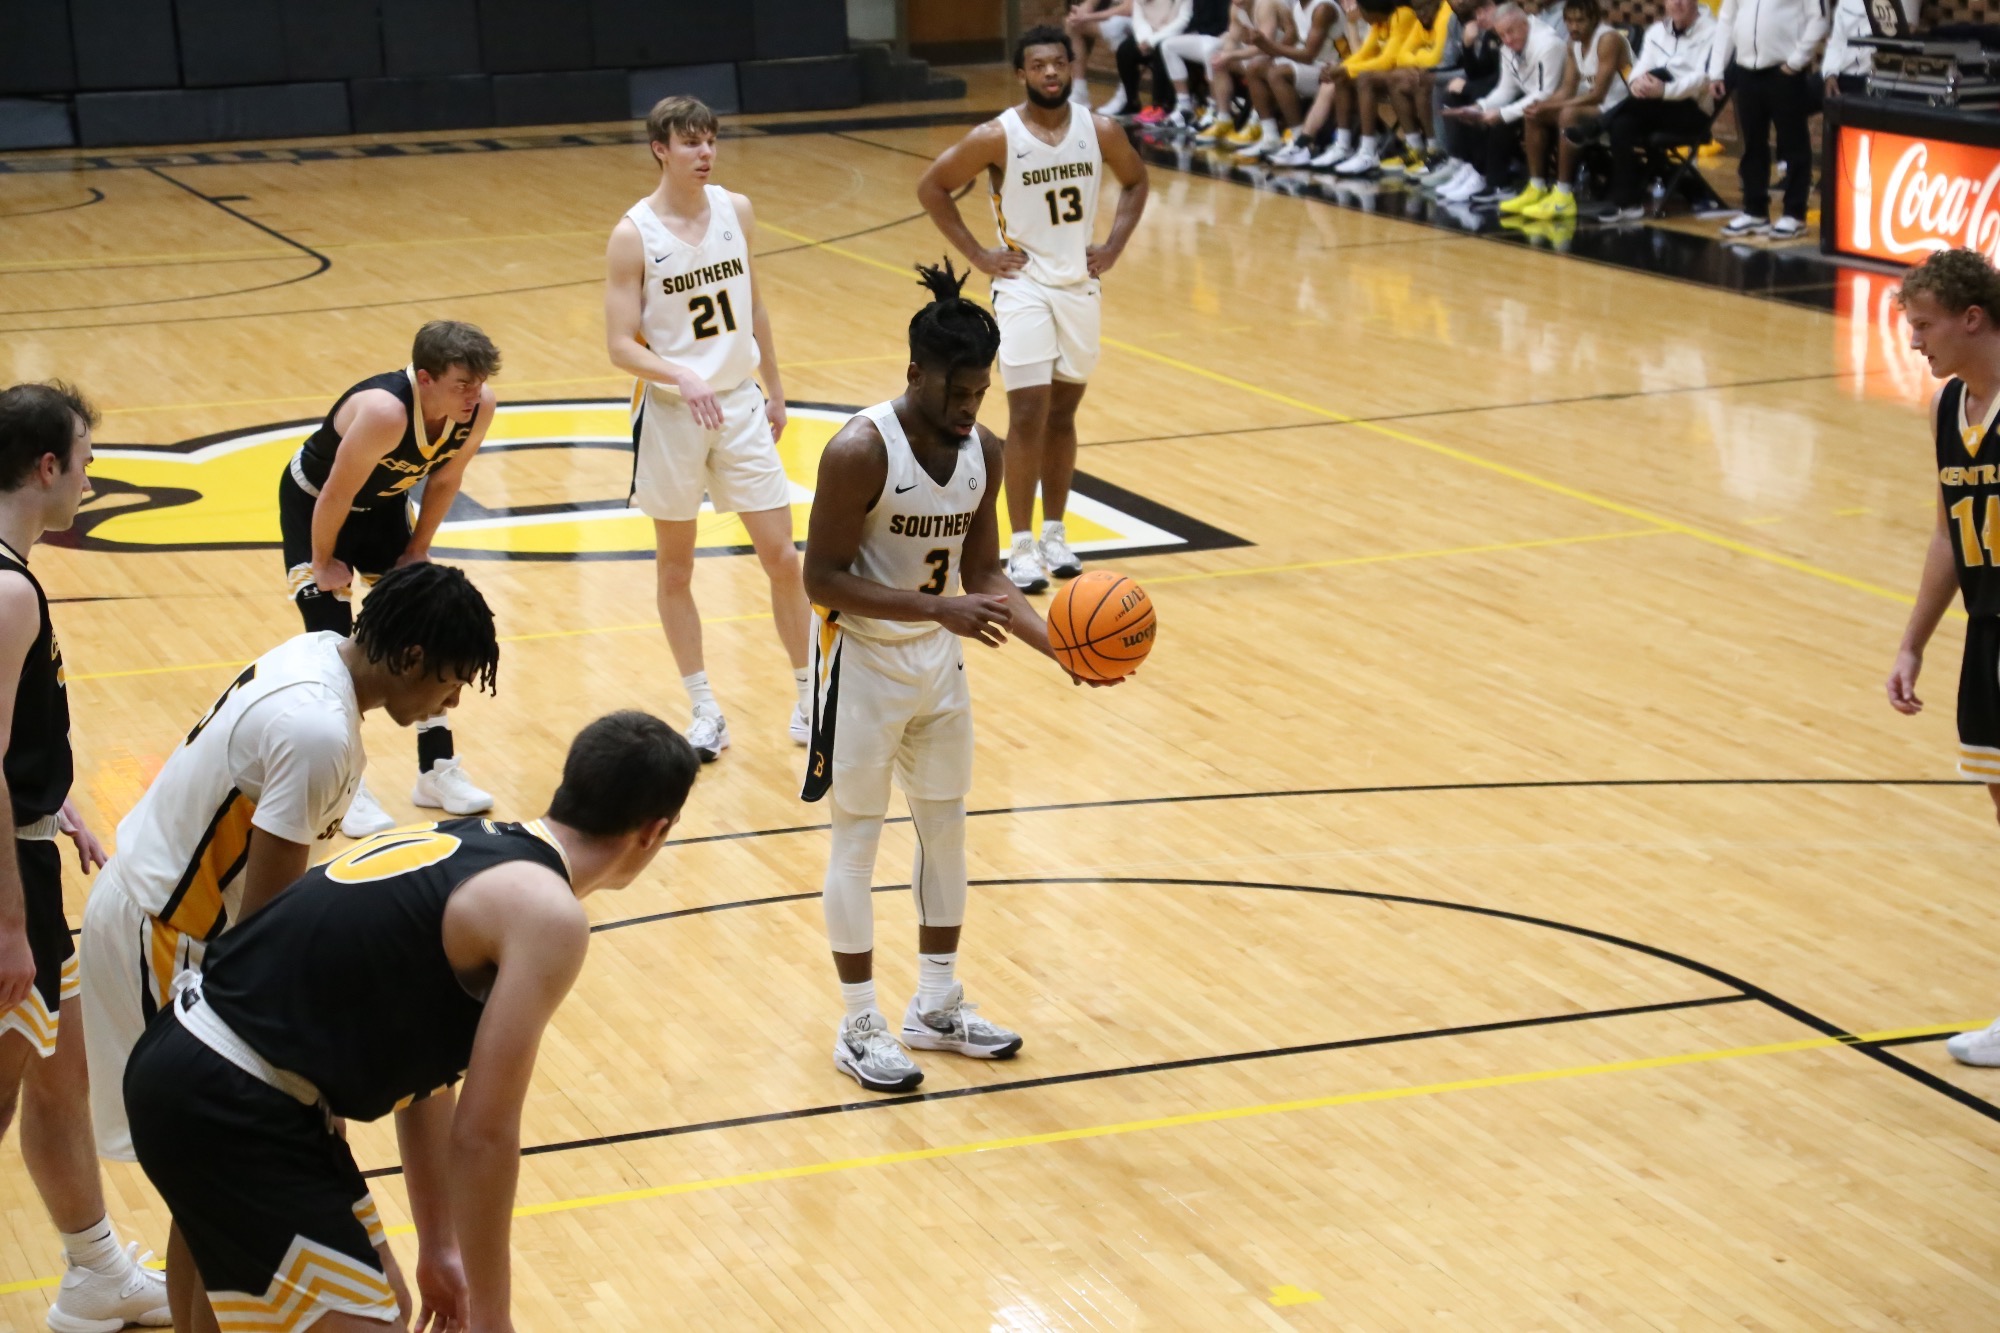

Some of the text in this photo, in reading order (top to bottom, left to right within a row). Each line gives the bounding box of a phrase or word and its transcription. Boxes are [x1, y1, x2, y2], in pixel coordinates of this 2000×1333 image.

[1022, 161, 1093, 186] SOUTHERN
[1045, 186, 1083, 226] 13
[1880, 142, 2000, 270] Coca-C
[662, 257, 744, 296] SOUTHERN
[688, 288, 737, 341] 21
[1940, 464, 2000, 486] CENTR
[889, 510, 976, 538] SOUTHER
[918, 547, 950, 596] 3
